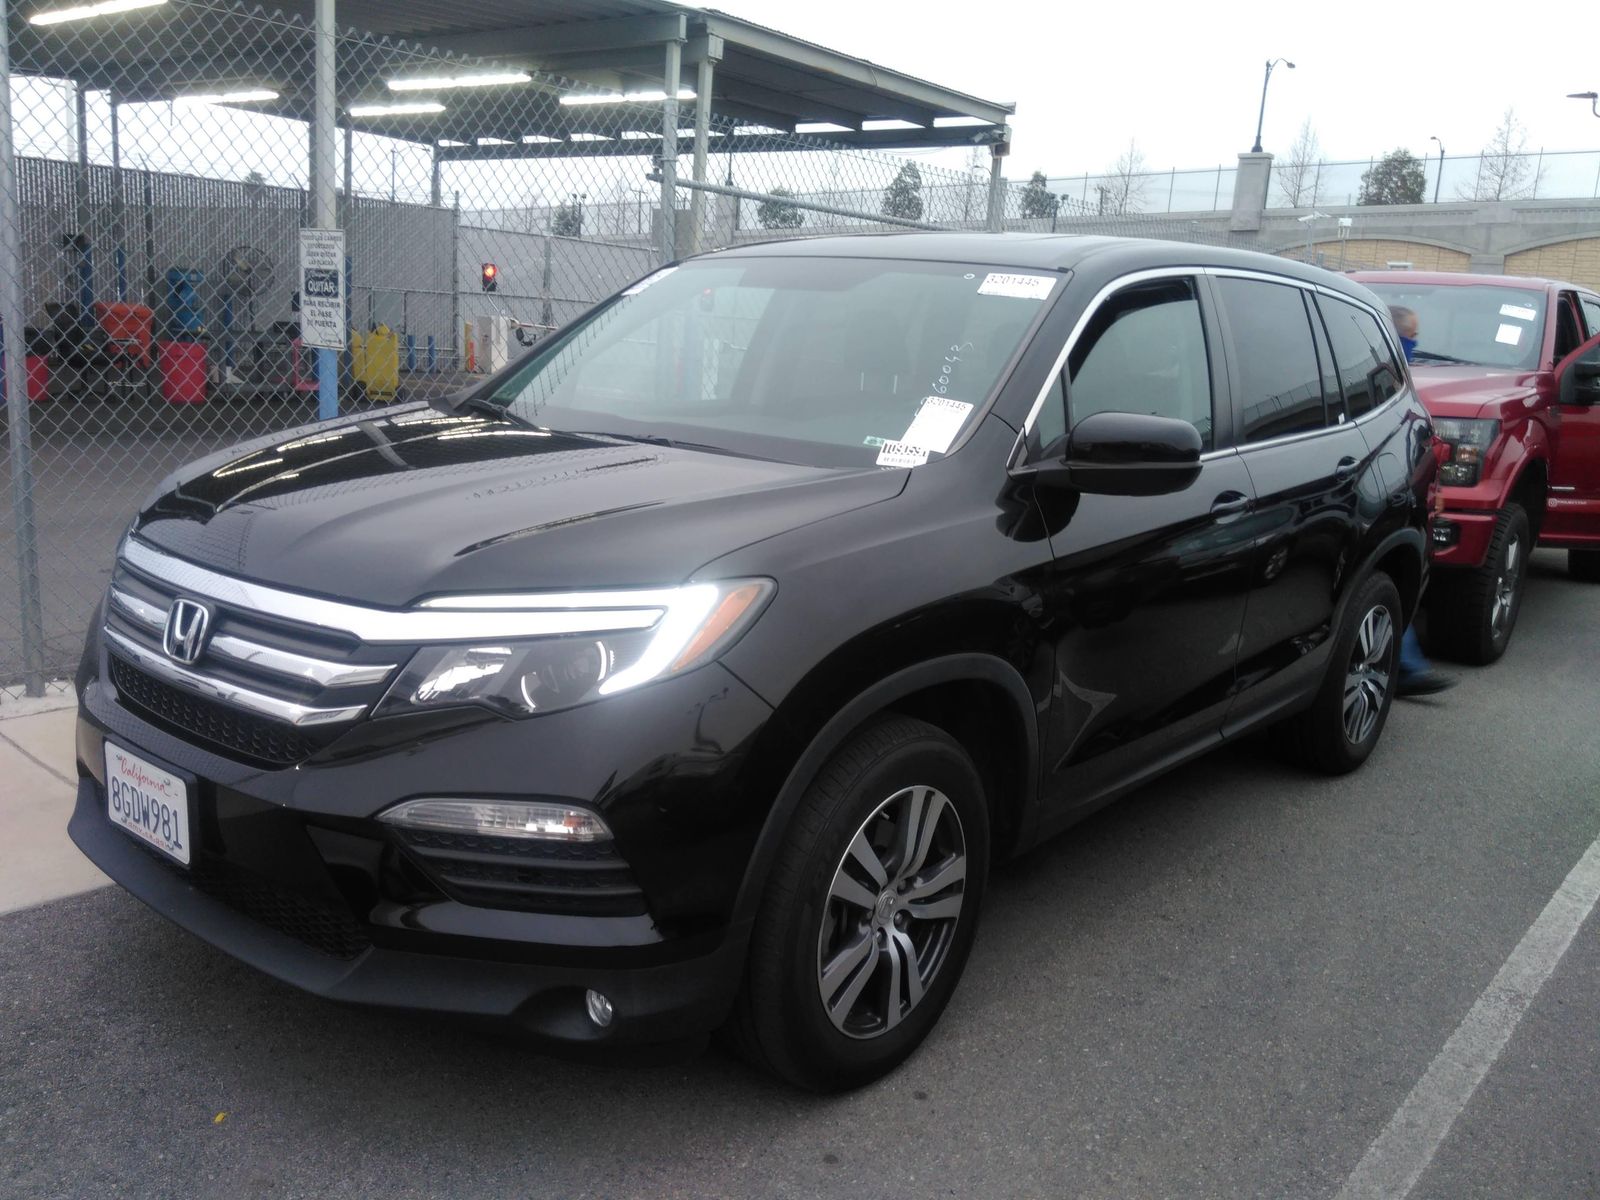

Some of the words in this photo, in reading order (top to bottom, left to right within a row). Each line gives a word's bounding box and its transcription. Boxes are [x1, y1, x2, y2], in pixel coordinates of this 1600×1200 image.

[308, 280, 335, 293] QUITAR
[119, 758, 171, 797] California
[111, 775, 183, 850] 8GDW981
